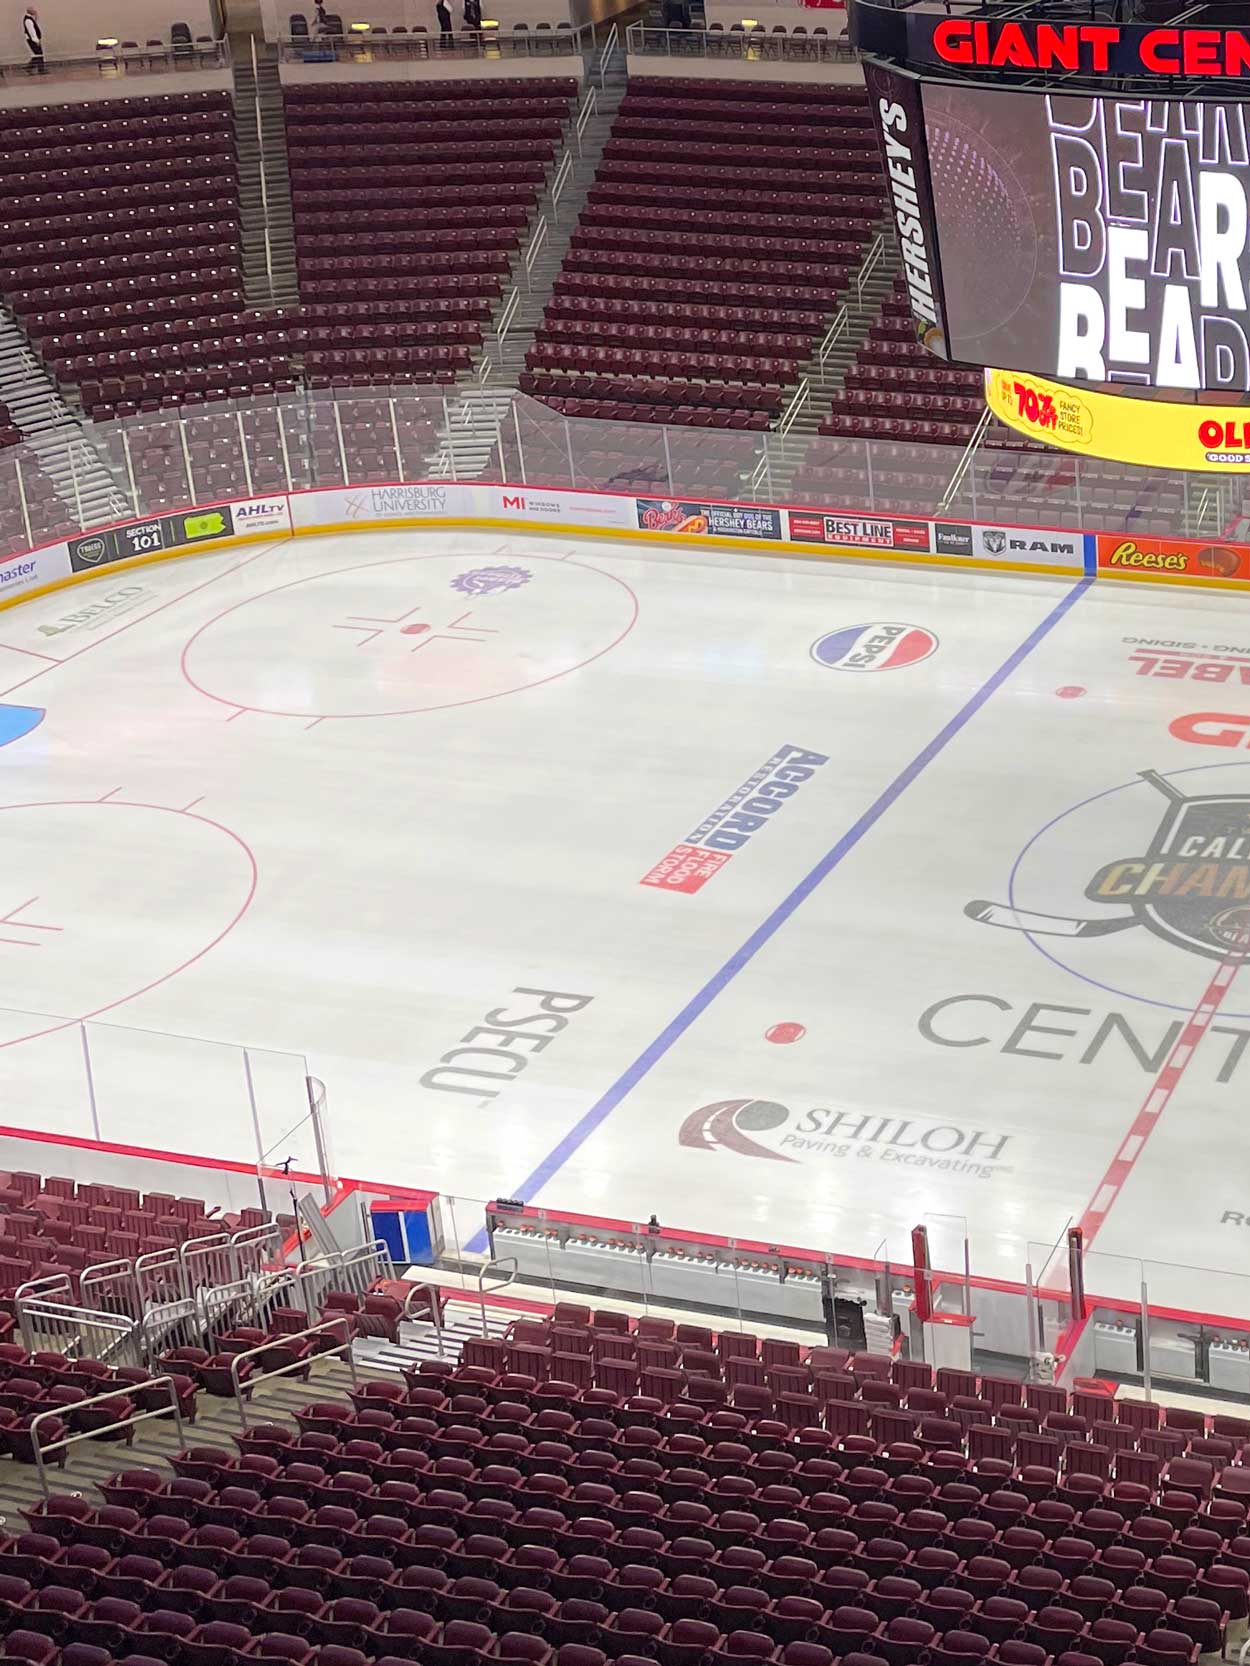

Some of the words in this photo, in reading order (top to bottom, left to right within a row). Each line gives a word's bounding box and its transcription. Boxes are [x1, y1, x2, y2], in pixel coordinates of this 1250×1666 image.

[933, 20, 1120, 71] GIANT
[880, 98, 937, 324] HERSHEY'S
[1060, 400, 1081, 414] FANCY
[1060, 411, 1081, 423] STORE
[371, 487, 446, 500] HARRISBURG
[503, 496, 526, 510] MI
[373, 498, 446, 512] UNIVERSITY
[126, 523, 162, 538] SECTION
[708, 516, 745, 528] HERSHEY
[746, 519, 774, 531] BEARS
[825, 519, 859, 537] BEST
[862, 521, 892, 538] LINE
[132, 532, 161, 551] 101
[827, 534, 892, 545] EQUIPMENT
[1009, 539, 1074, 554] RAM
[1110, 541, 1188, 570] Reese's
[842, 625, 907, 668] PEPSI
[1122, 637, 1198, 650] SIDING
[703, 745, 830, 851] ACCORD
[646, 847, 692, 884] STORM
[666, 850, 707, 884] FLOOD
[699, 853, 727, 878] FIRE
[418, 986, 595, 1098] PSECU
[795, 1108, 1014, 1161] SHILOH
[780, 1134, 852, 1158] Paving
[856, 1144, 873, 1159] &
[879, 1148, 995, 1180] Excavating
